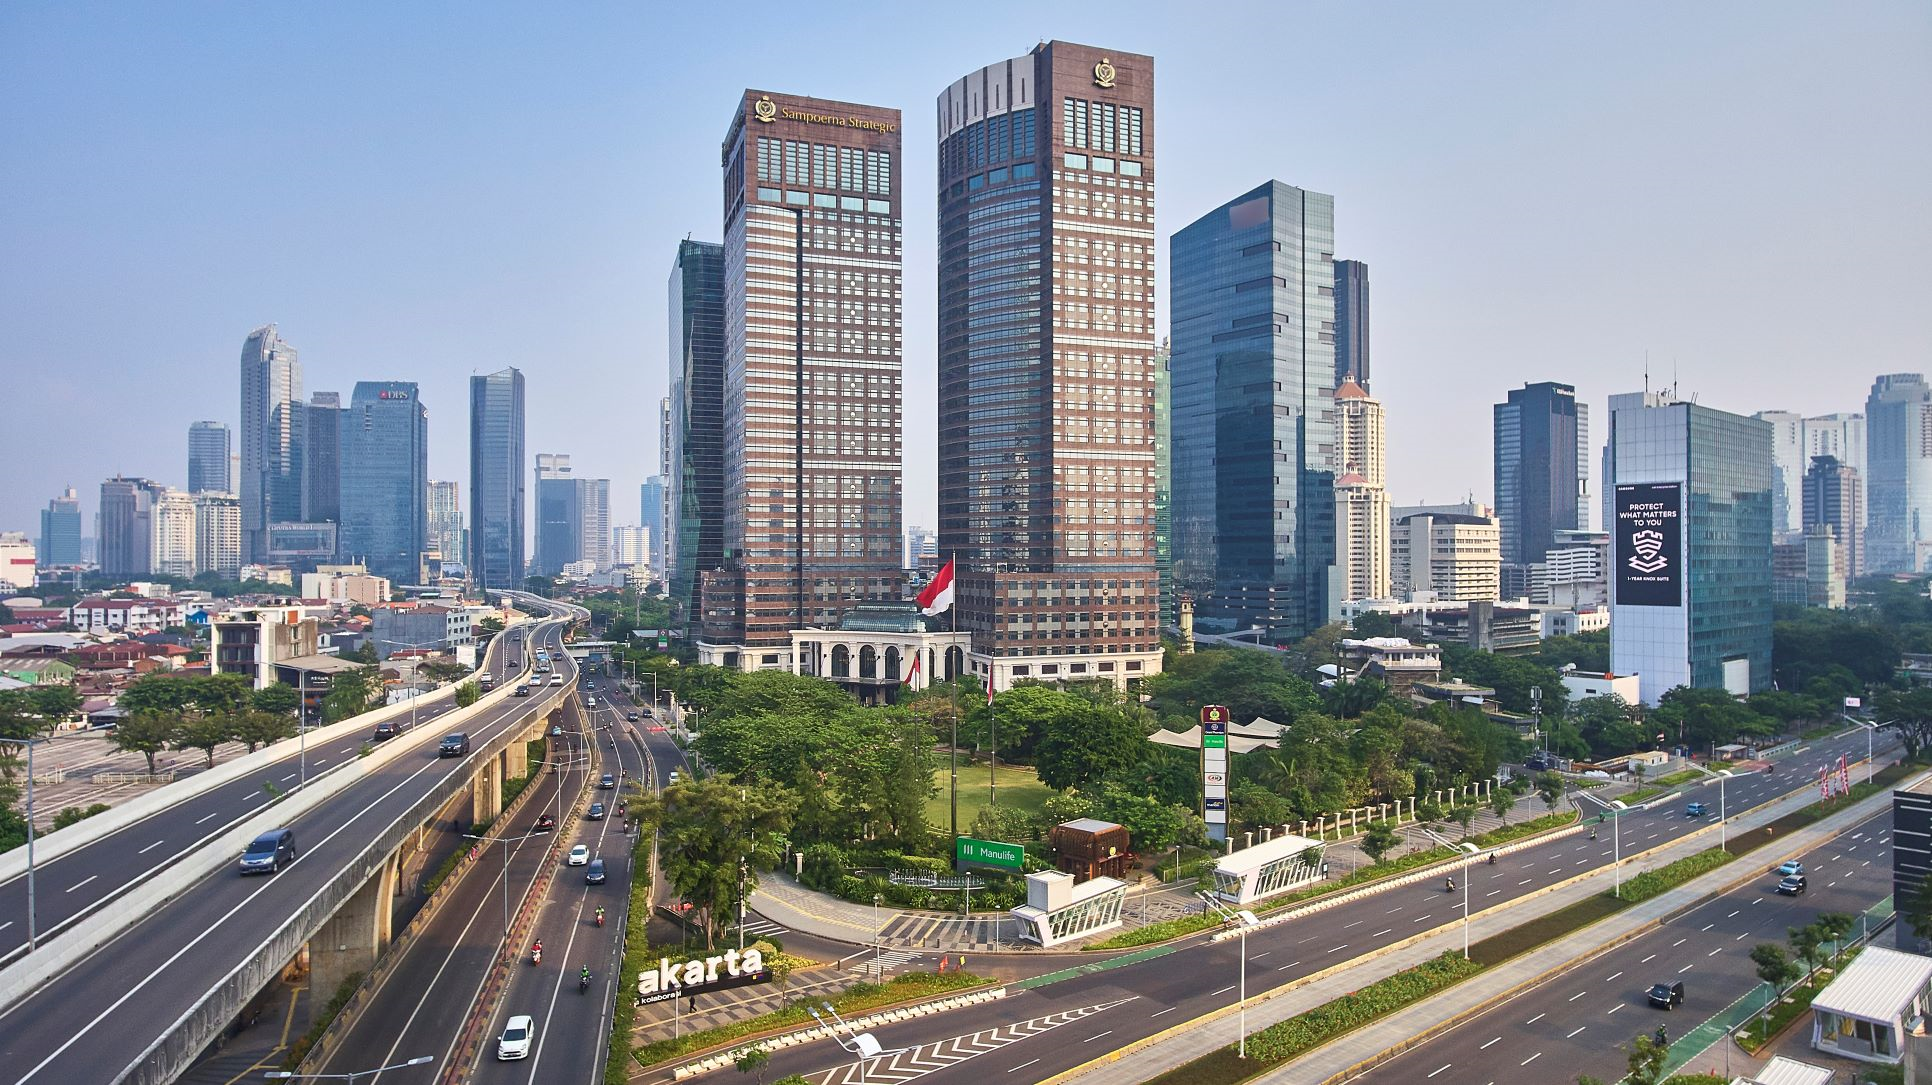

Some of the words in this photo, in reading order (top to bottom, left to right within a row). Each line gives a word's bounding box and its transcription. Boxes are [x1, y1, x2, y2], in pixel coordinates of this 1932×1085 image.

[781, 107, 846, 126] Sampoerna
[848, 116, 896, 134] Strategic
[388, 390, 408, 399] DBS
[1629, 503, 1664, 511] PROTECT
[1619, 511, 1642, 519] WHAT
[1642, 510, 1677, 518] MATTERS
[1633, 519, 1645, 527] TO
[980, 847, 1015, 861] Manulife
